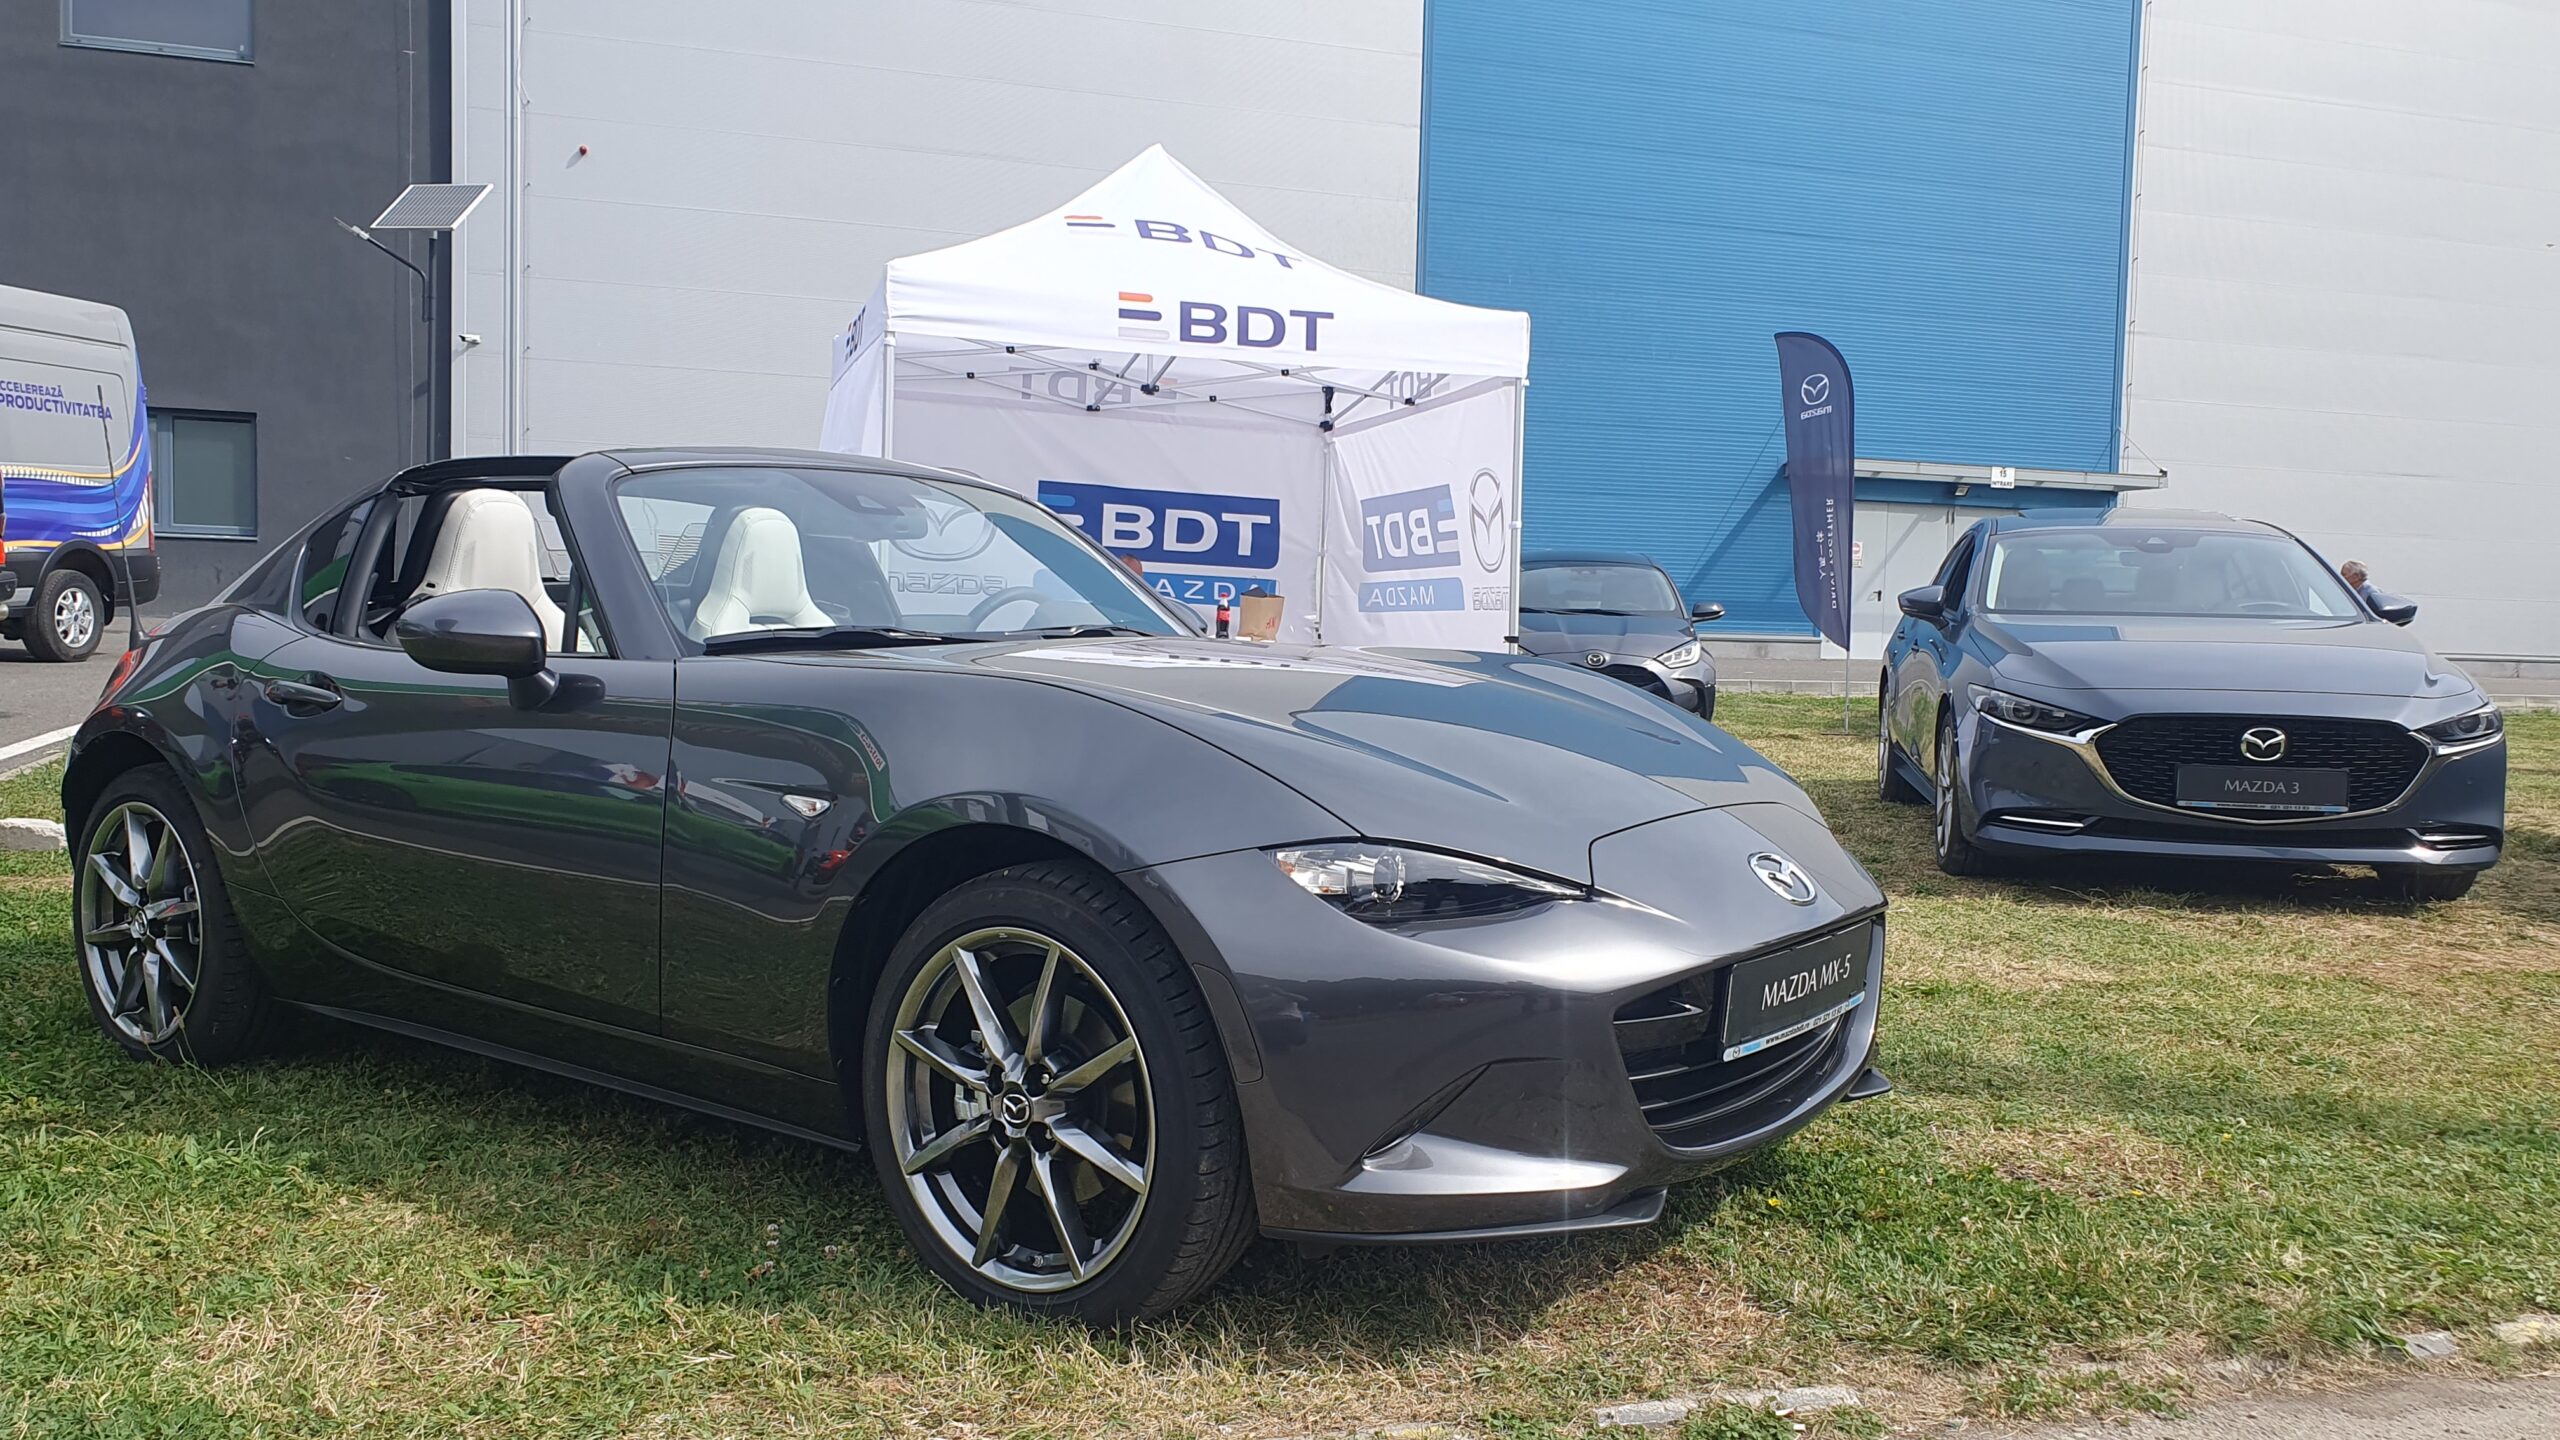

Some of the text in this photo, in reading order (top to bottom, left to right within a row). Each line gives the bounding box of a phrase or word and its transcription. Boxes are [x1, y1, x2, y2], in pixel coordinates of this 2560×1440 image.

[1134, 219, 1302, 270] BDT
[1180, 301, 1334, 352] BDT
[1102, 503, 1271, 556] BDT
[1154, 577, 1260, 601] AZD
[2224, 779, 2300, 794] MAZDA 3
[1761, 953, 1852, 1011] MAZDA MX-5
